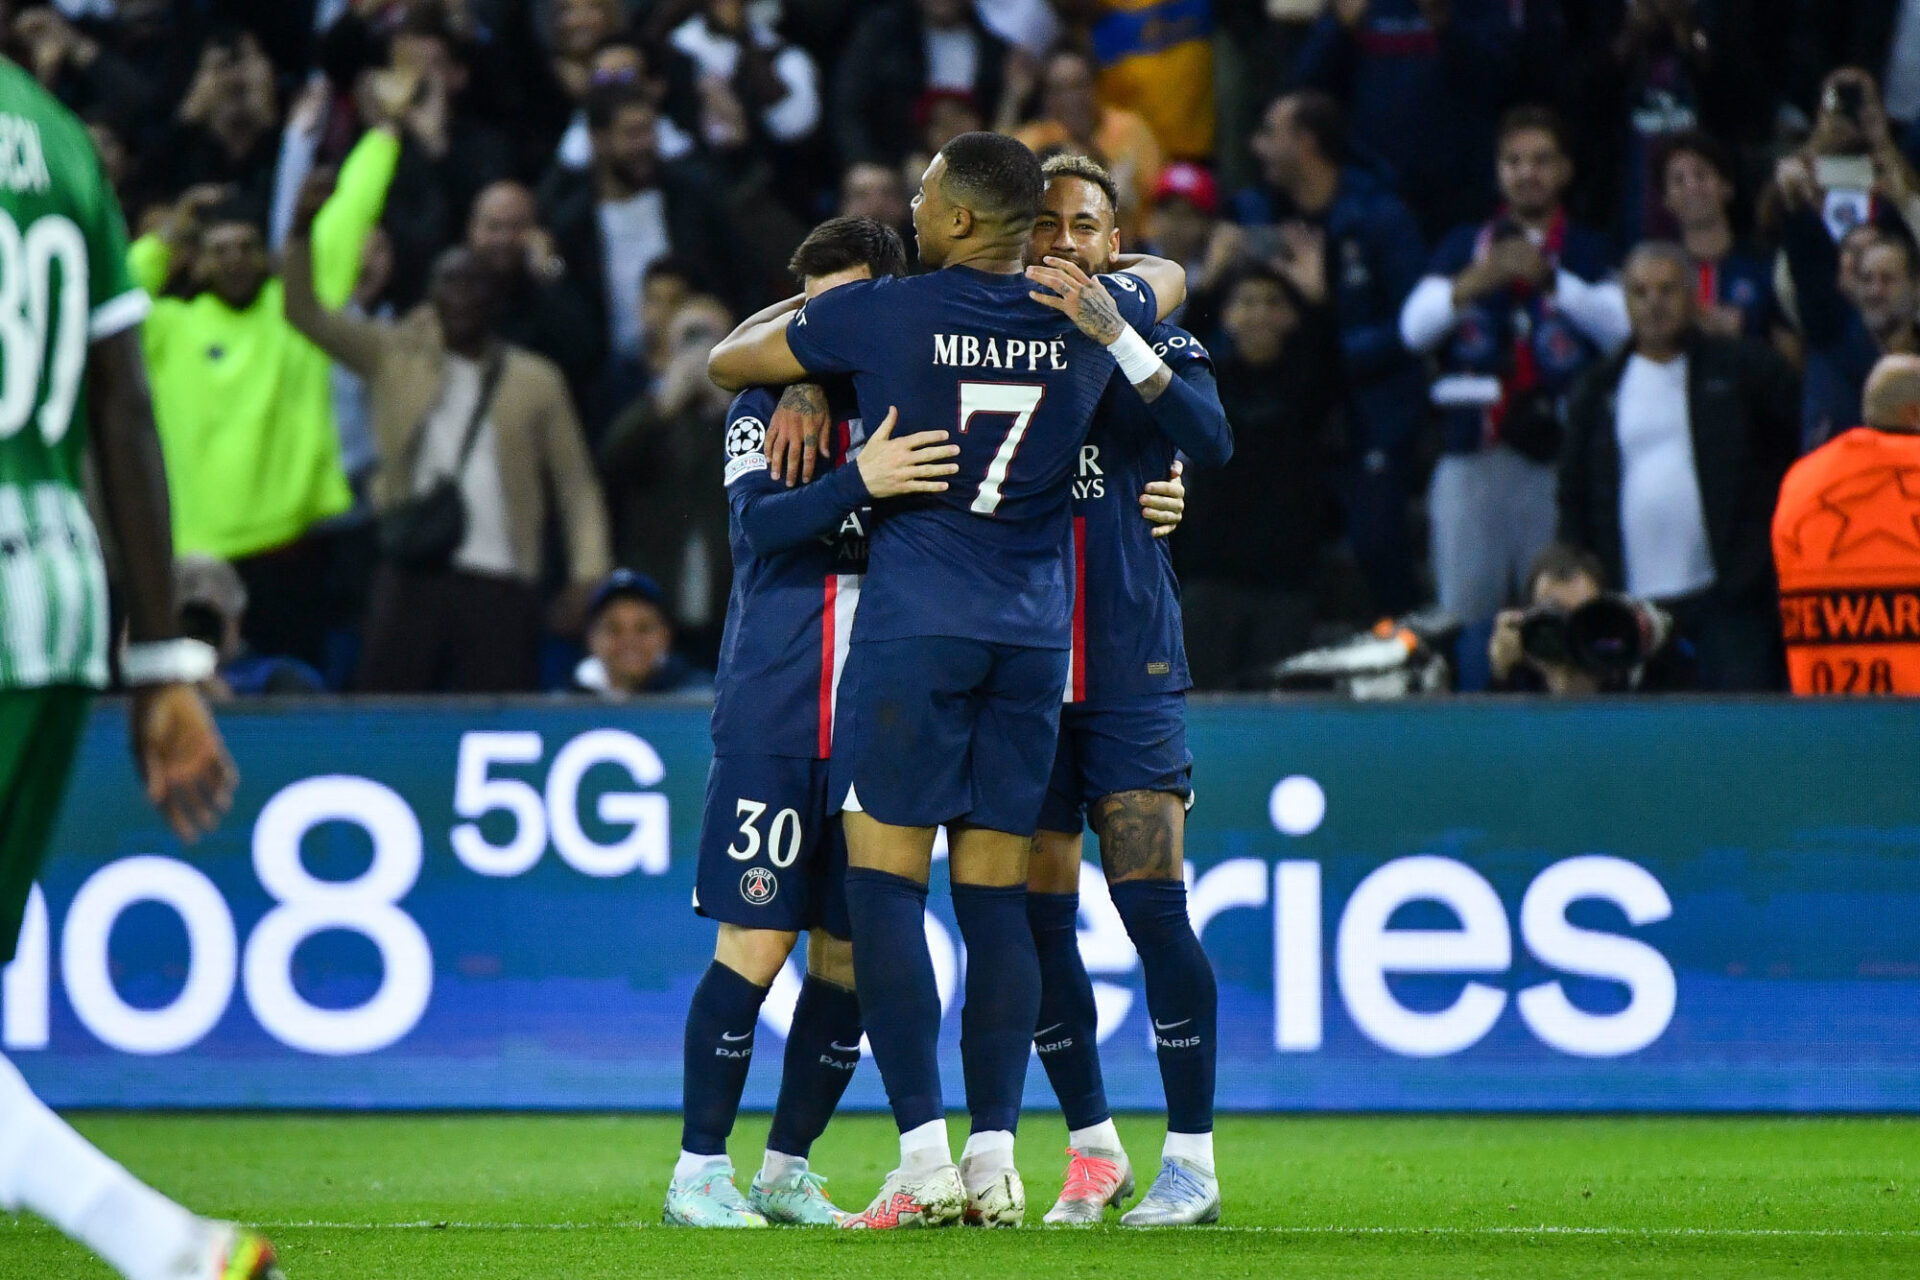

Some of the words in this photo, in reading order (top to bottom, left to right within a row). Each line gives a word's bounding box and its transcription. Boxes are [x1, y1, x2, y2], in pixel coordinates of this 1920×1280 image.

[933, 333, 1068, 371] MBAPPÉ
[958, 380, 1046, 516] 7
[450, 729, 670, 877] 5G
[727, 798, 802, 868] 30
[747, 869, 772, 880] PARIS
[1037, 1038, 1072, 1052] ARIS
